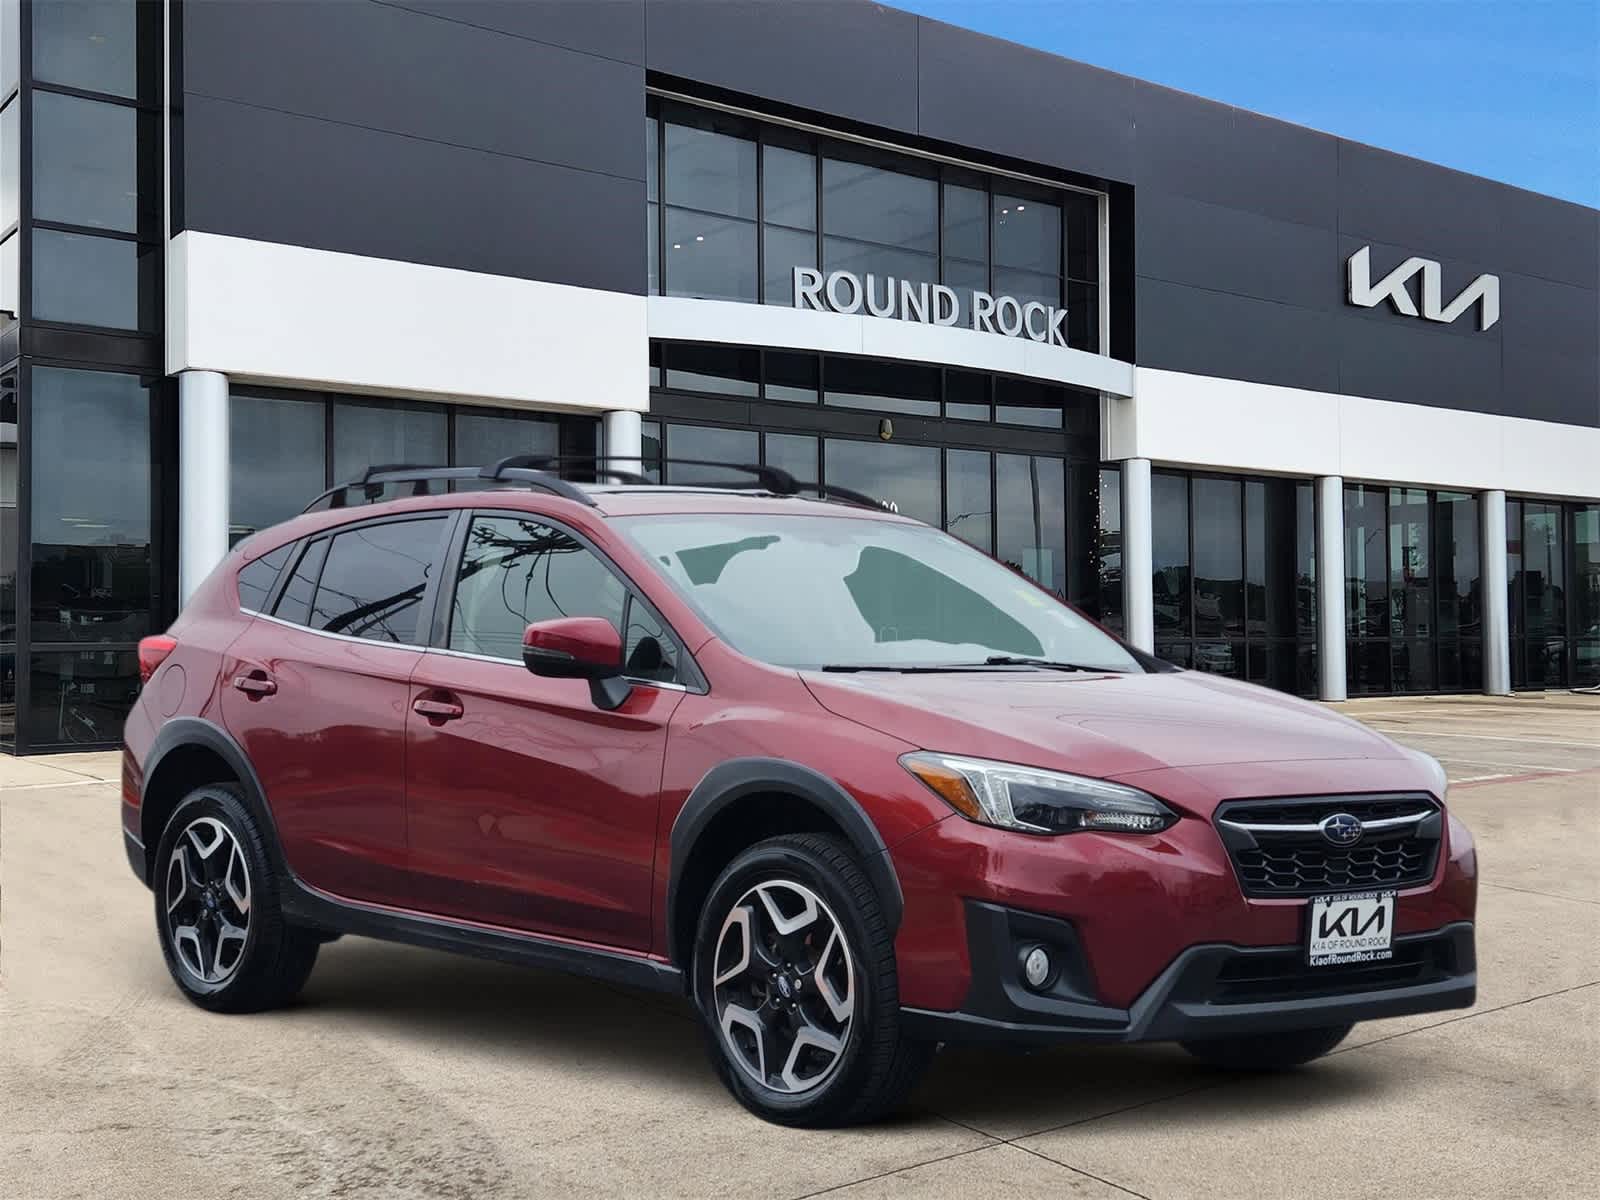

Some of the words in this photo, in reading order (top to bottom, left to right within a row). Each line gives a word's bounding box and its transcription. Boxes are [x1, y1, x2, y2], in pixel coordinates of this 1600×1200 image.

[793, 265, 960, 327] ROUND
[972, 290, 1068, 347] ROCK
[1348, 245, 1500, 331] KIA
[1312, 942, 1326, 950] KIA
[1328, 941, 1339, 949] OF
[1340, 939, 1367, 949] ROUND
[1368, 937, 1388, 946] ROCK
[1319, 905, 1385, 939] KIA
